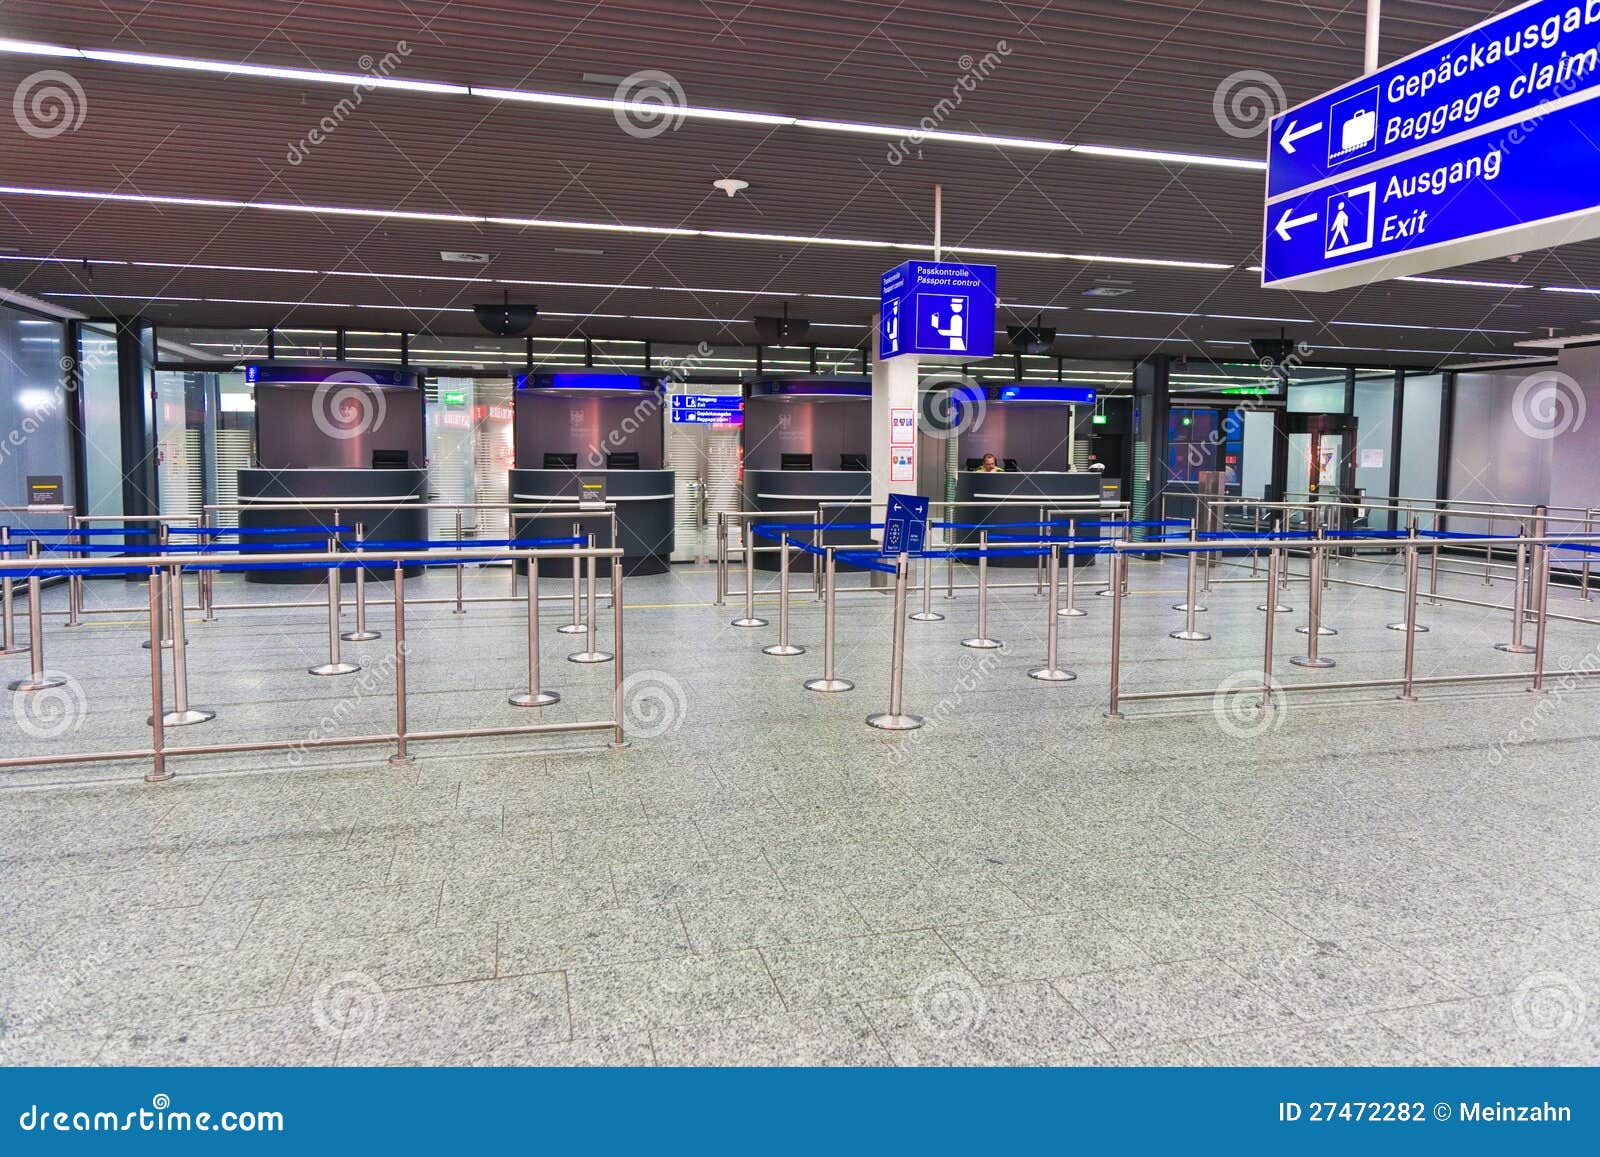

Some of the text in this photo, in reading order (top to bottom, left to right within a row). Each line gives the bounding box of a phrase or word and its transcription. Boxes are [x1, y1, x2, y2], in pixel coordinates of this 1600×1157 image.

[1384, 48, 1598, 145] Baggage claim
[1383, 150, 1501, 203] Ausgang
[1380, 210, 1428, 243] Exit
[917, 266, 969, 277] Passkontrolle
[917, 276, 980, 287] Passport control
